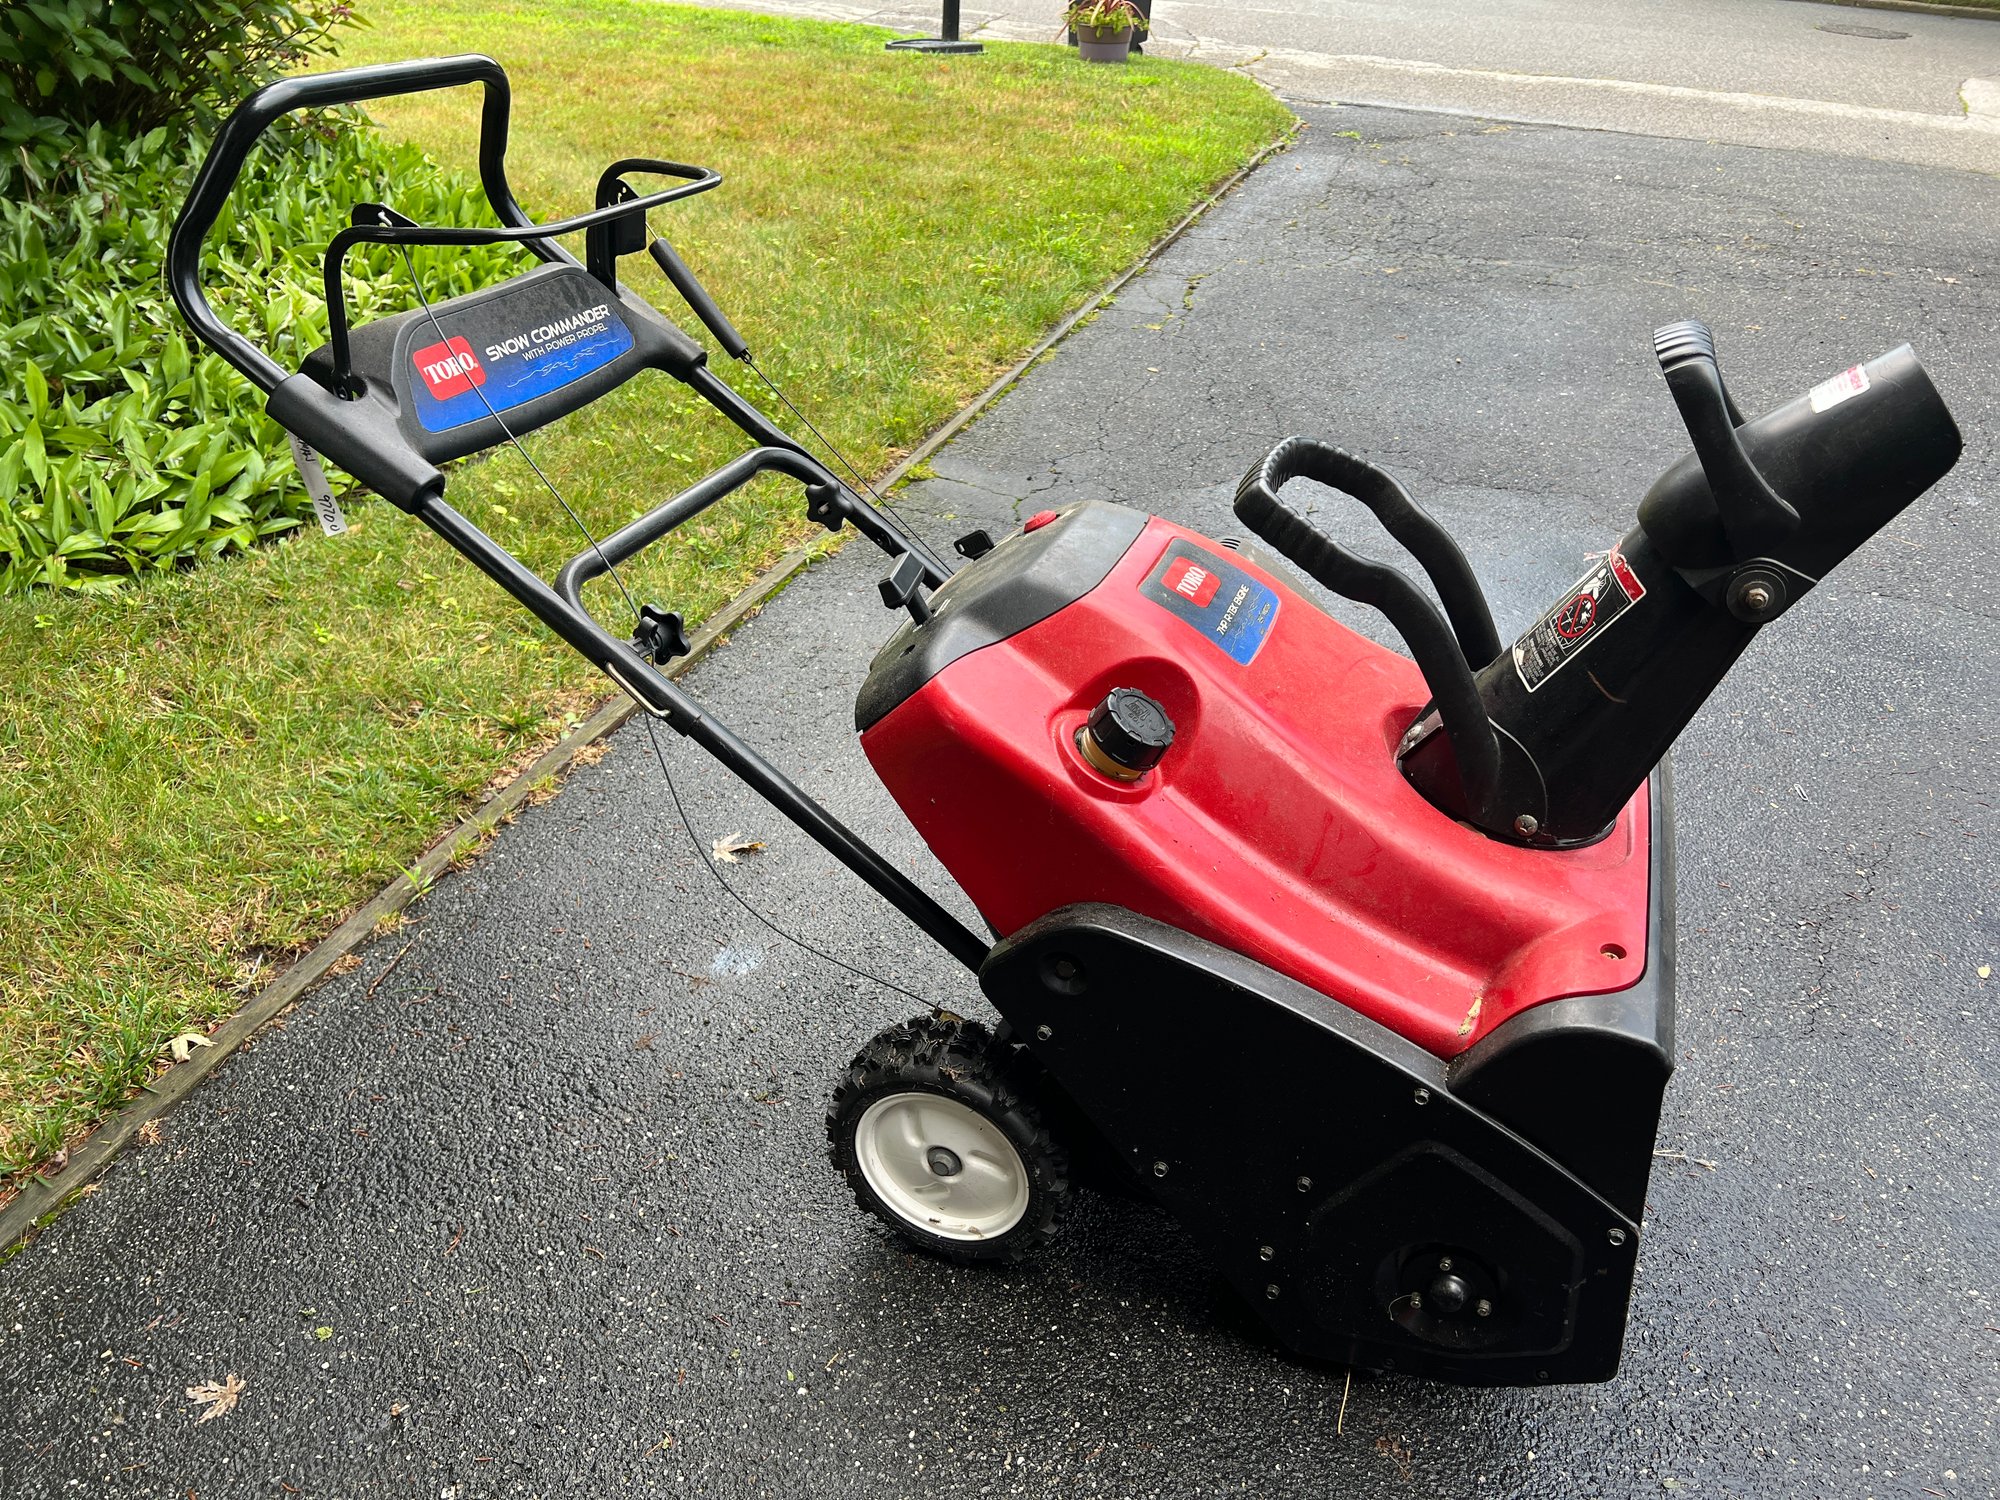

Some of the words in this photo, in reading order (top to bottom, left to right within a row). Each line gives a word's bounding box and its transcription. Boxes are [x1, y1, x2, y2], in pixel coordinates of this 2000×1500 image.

[485, 334, 530, 362] SNOW
[531, 304, 611, 347] COMMANDER
[522, 346, 545, 362] WITH
[547, 334, 576, 352] POWER
[577, 322, 608, 339] PROPEL
[423, 352, 476, 385] TORO
[1176, 566, 1207, 598] TORO
[1233, 583, 1250, 605] ENGINE
